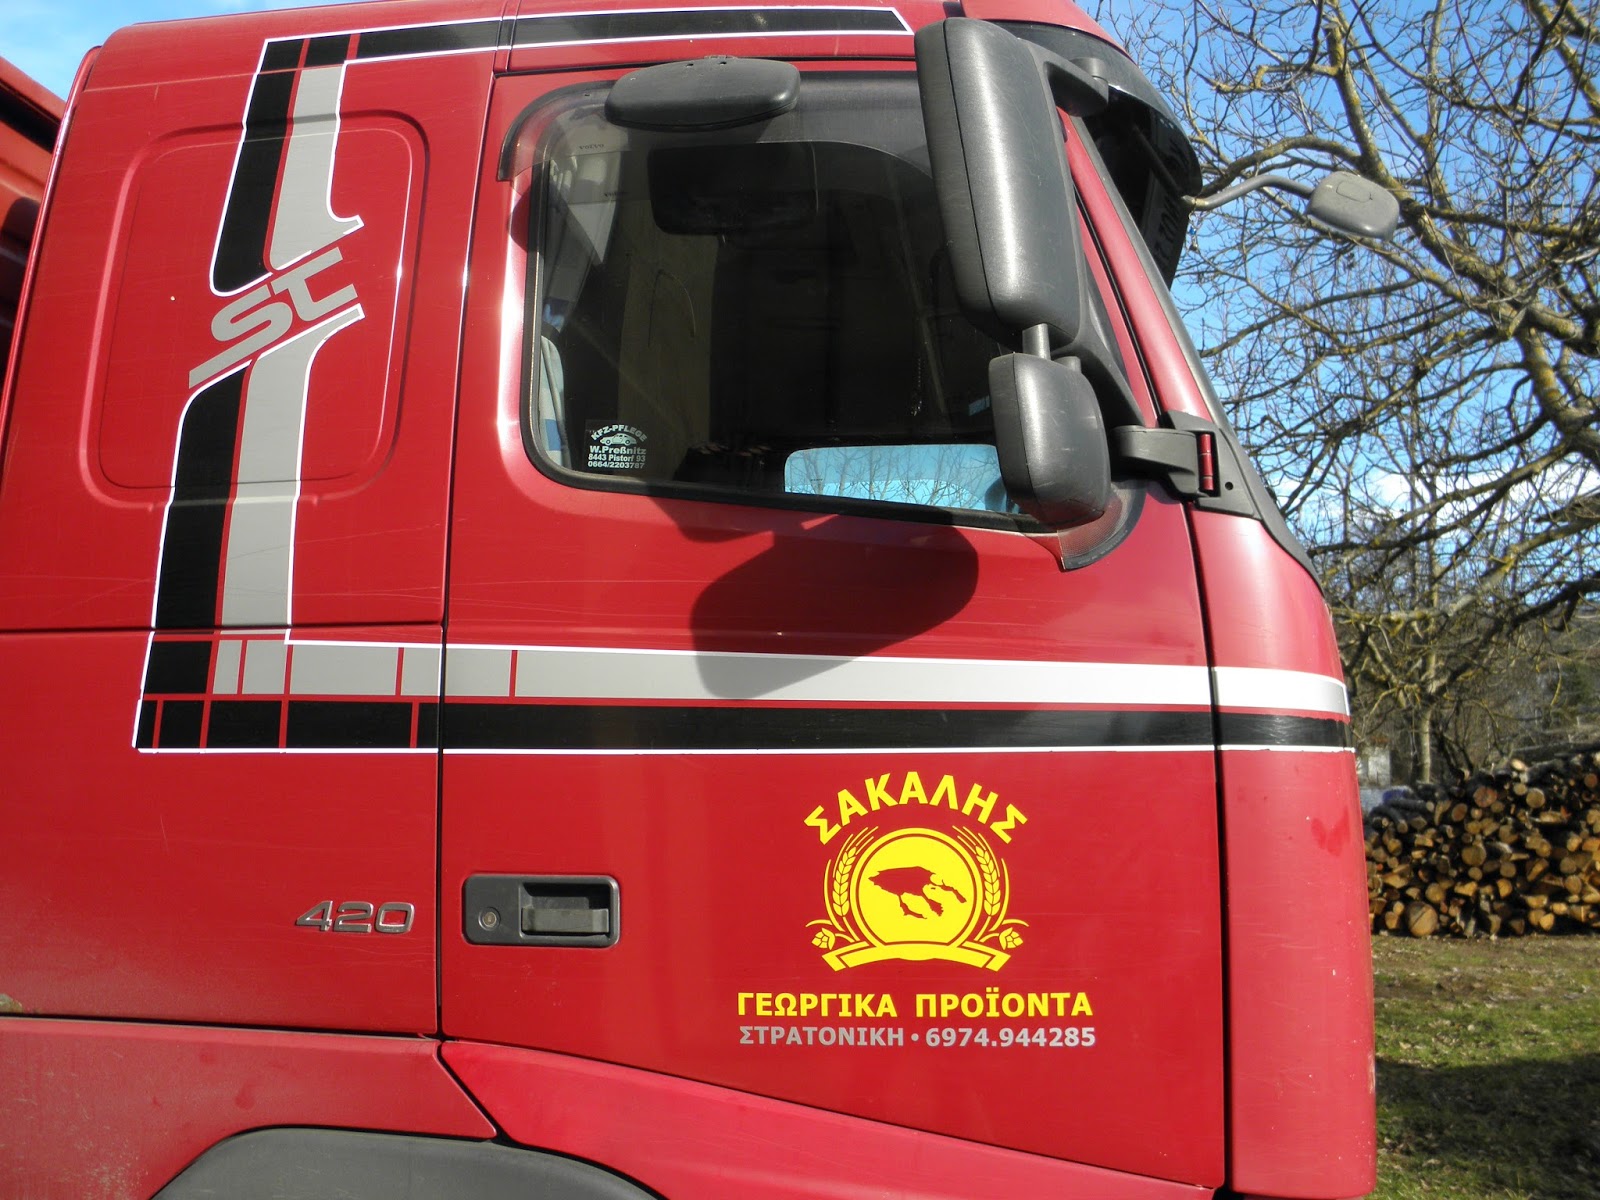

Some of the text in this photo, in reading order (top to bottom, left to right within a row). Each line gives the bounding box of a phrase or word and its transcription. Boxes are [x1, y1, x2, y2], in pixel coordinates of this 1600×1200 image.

[591, 425, 647, 441] KFZ-PFLEGE
[588, 453, 607, 461] 8443
[804, 771, 1028, 845] ΣΑΚΑΛΗΣ
[295, 900, 415, 934] 420
[737, 987, 1093, 1018] ΓΕΩΡΓΙΚΑ ΠΡΟΪΟΝΤΑ
[739, 1026, 1096, 1048] ΣΤΡΑΤΟΝΙΚΗ 6974.944285
